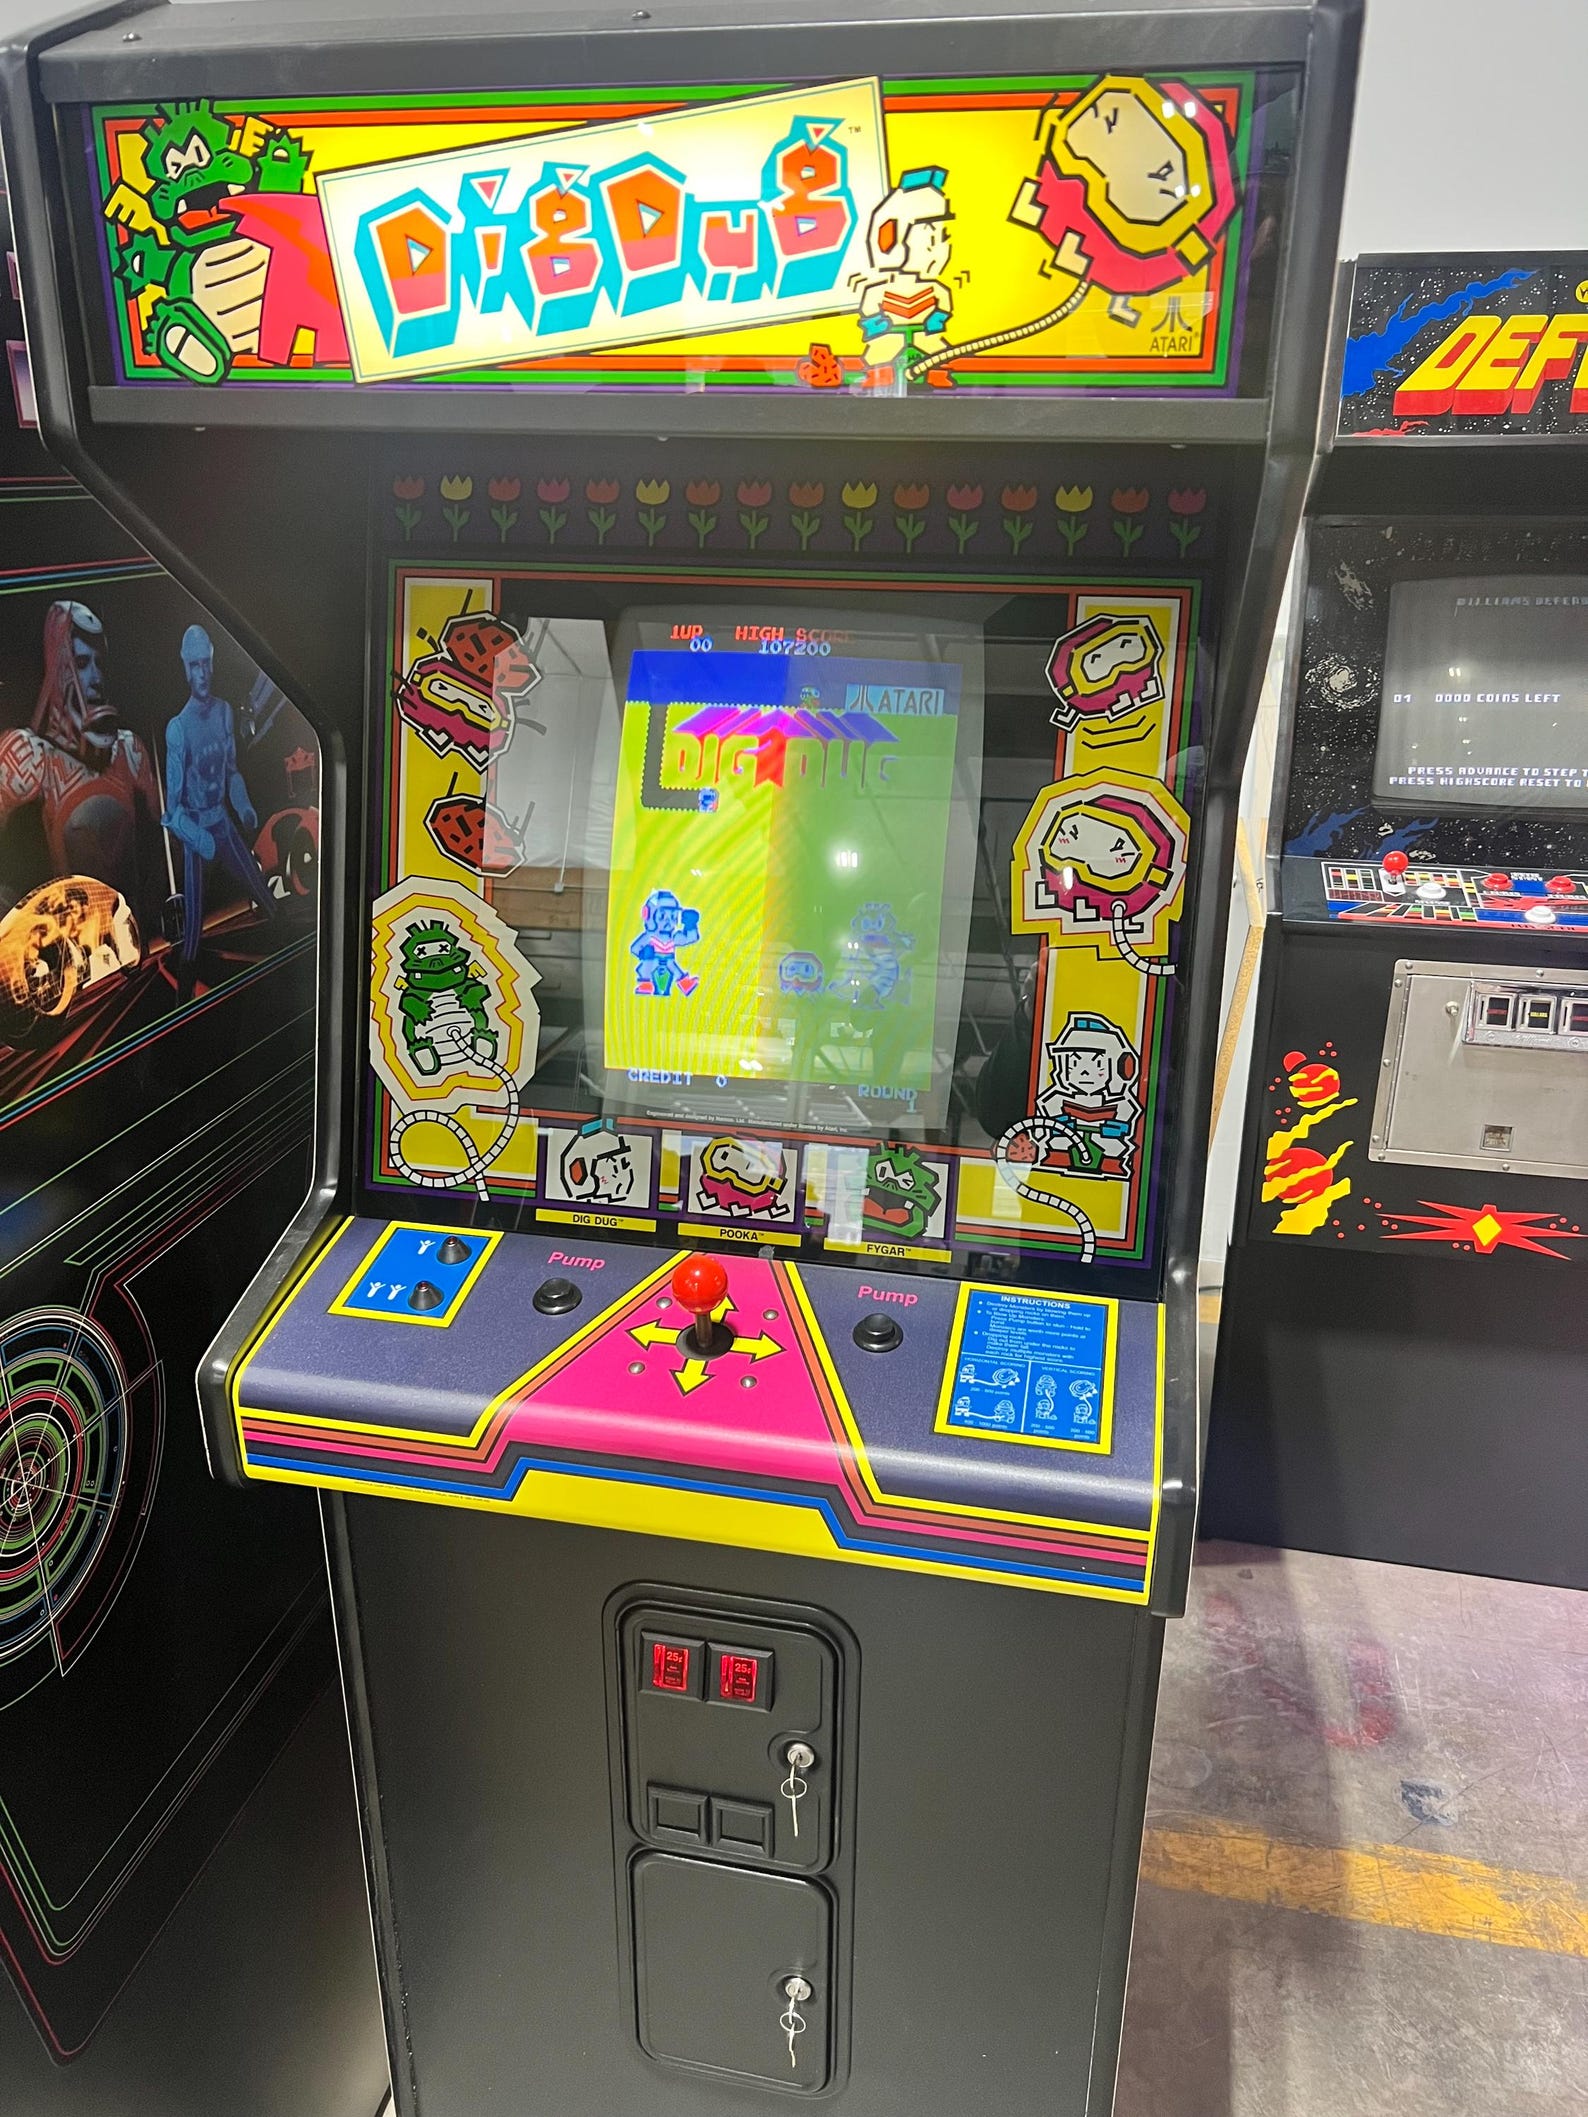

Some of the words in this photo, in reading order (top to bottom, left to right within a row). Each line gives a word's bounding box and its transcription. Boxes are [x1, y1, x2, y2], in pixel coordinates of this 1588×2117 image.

[670, 624, 704, 640] 1UP
[735, 625, 785, 641] HIGH
[758, 639, 832, 656] 107200
[878, 688, 940, 714] ATARI
[1476, 693, 1519, 703] COINS
[1525, 693, 1561, 703] LEFT
[672, 730, 760, 789] DIG
[1408, 766, 1453, 775] PRESS
[1458, 767, 1519, 776] ADVANCE
[1523, 767, 1539, 776] TO
[1543, 768, 1578, 777] STEP
[1389, 776, 1434, 785] PRESS
[1439, 777, 1515, 786] HIGHSCORE
[1519, 778, 1561, 787] RESET
[1565, 778, 1582, 788] TO
[627, 1068, 693, 1086] CREDIT
[716, 1075, 728, 1088] 0
[858, 1084, 917, 1102] ROUND
[907, 1099, 917, 1114] 1
[572, 1214, 591, 1225] DIG
[547, 1251, 606, 1271] Pump
[857, 1284, 919, 1307] Pump
[1001, 1295, 1071, 1309] INSTRUCTIONS
